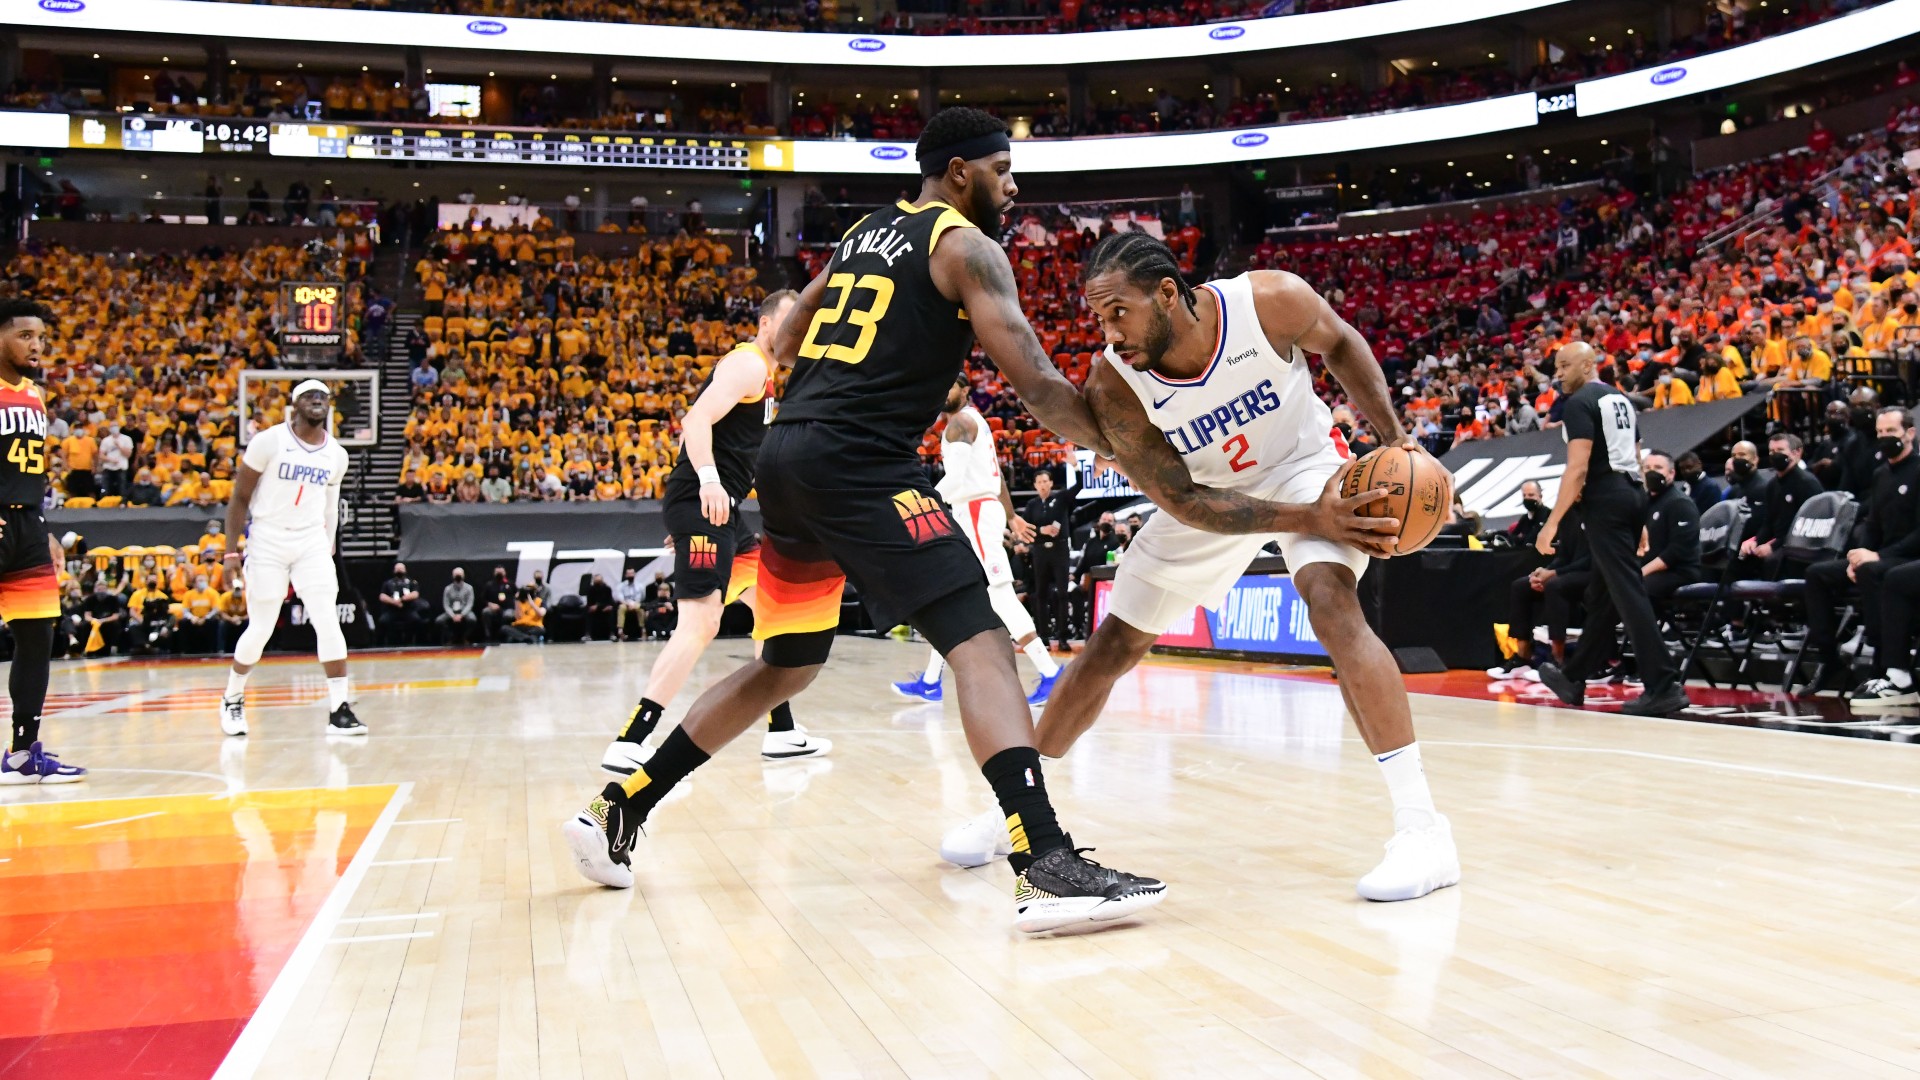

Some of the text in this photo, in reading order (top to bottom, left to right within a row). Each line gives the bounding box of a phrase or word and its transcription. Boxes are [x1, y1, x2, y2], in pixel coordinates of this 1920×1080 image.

[469, 20, 505, 33] Carrier
[1211, 27, 1242, 39] Carrier
[850, 39, 883, 51] Carrier
[205, 124, 268, 142] 10:42
[1234, 135, 1266, 146] Carrier
[872, 147, 905, 158] Carrier
[841, 228, 913, 267] O'NEALE
[295, 286, 337, 304] 10:42
[305, 303, 332, 332] 10
[798, 273, 895, 364] 23
[1226, 347, 1259, 366] honey
[0, 407, 47, 440] UTAH
[1163, 379, 1280, 455] CLIPPERS
[1612, 402, 1631, 429] 23
[7, 438, 45, 474] 45
[1222, 433, 1258, 473] 2
[278, 462, 331, 486] CLIPPERS
[294, 485, 304, 506] 1
[1226, 587, 1282, 641] PLAYOFFS
